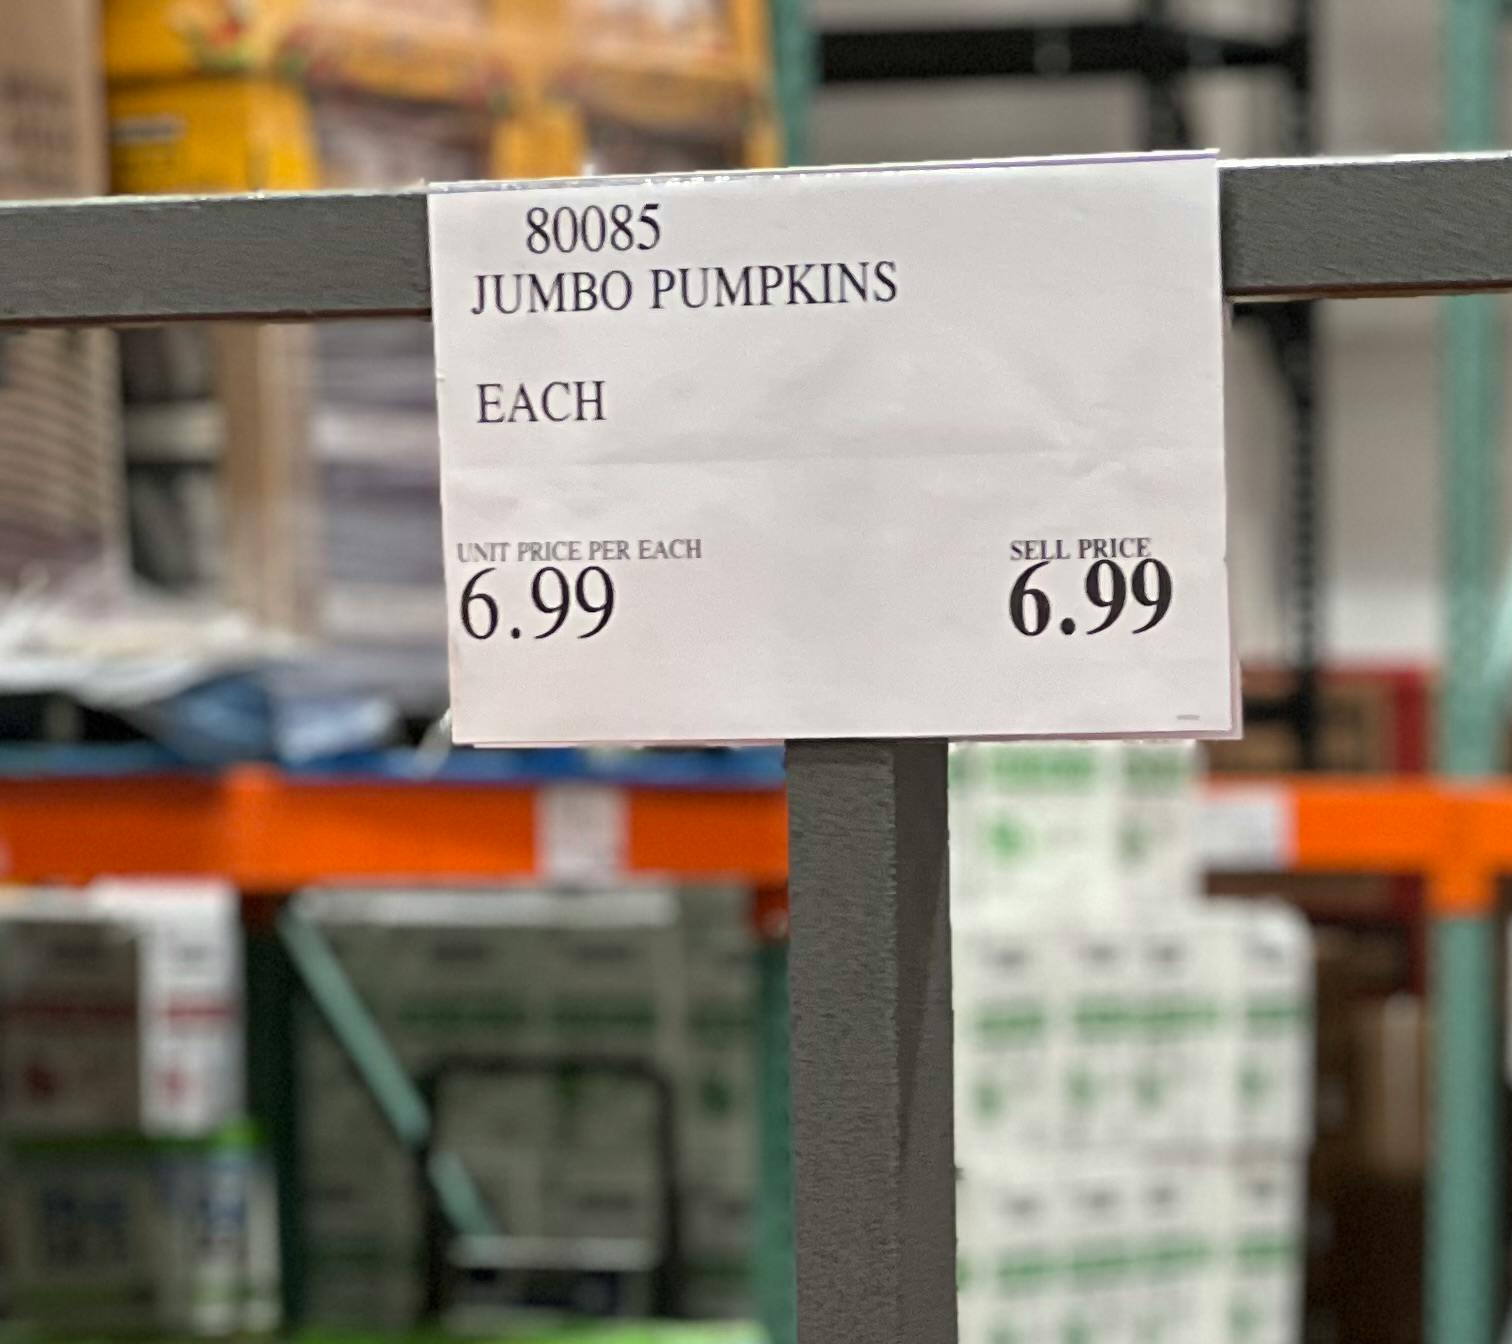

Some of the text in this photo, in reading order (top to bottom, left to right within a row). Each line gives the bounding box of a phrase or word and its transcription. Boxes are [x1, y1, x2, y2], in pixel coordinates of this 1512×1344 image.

[526, 203, 662, 255] 80085
[471, 260, 898, 316] JUMBO PUMPKINS
[476, 379, 607, 424] EACH
[456, 538, 703, 564] UNIT PRICE PER EACH
[1010, 537, 1152, 561] SELL PRICE
[460, 565, 616, 641] 6.99
[1008, 557, 1173, 638] 6.99
